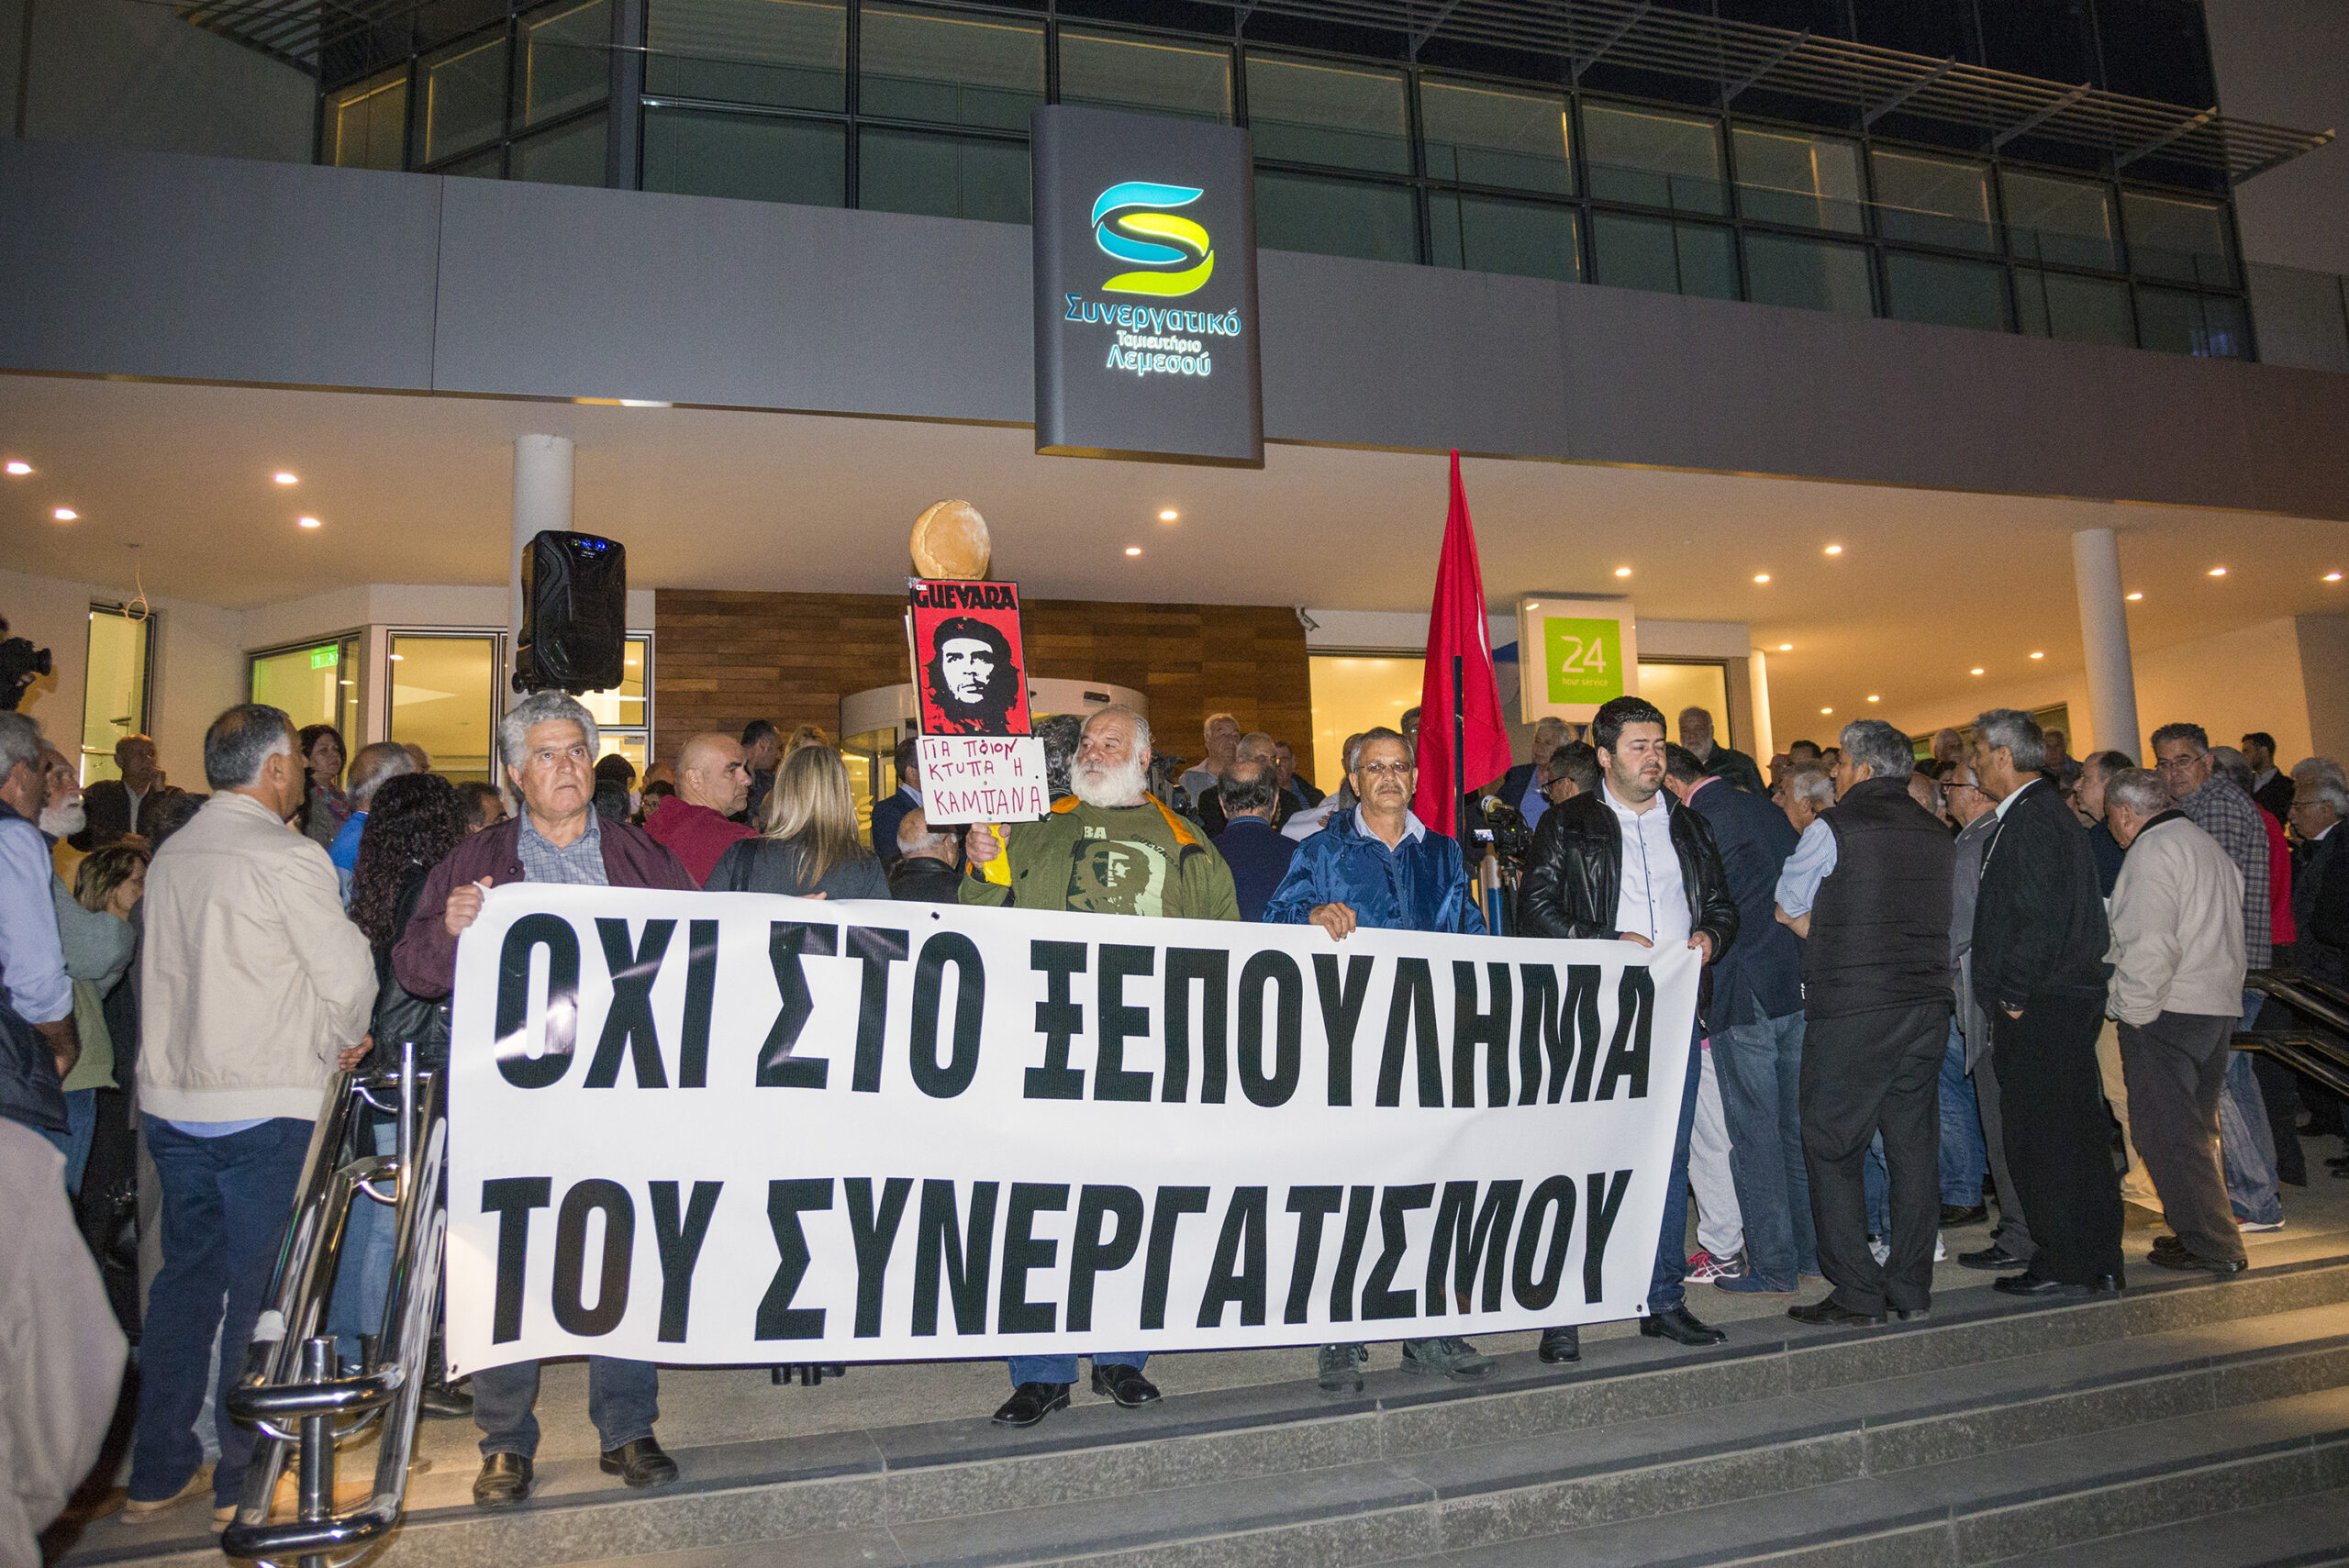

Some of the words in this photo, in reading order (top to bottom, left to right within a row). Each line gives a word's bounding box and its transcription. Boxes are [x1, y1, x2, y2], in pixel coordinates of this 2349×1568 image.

[1064, 293, 1241, 336] Συνεργατικό
[1117, 329, 1202, 353] Ταμιευτήριο
[1107, 344, 1211, 376] Λεμεσού
[914, 584, 1018, 610] GUEVARA
[1561, 636, 1607, 673] 24
[1562, 677, 1579, 685] hour
[1582, 678, 1608, 687] service
[923, 739, 951, 760] ΓΙΑ
[963, 738, 1018, 761] ΠΟΙΟΝ
[934, 786, 1042, 816] ΚΑΜΠΑΝΑ
[494, 913, 719, 1089] ΟΧΙ
[755, 920, 985, 1099] ΣΤΟ
[1023, 940, 1655, 1108] ΞΕΠΟΥΛΗΜΑ
[481, 1176, 725, 1346] ΤΟΥ
[753, 1169, 1633, 1342] ΣΥΝΕΡΓΑΤΙΣΜΟΥ
